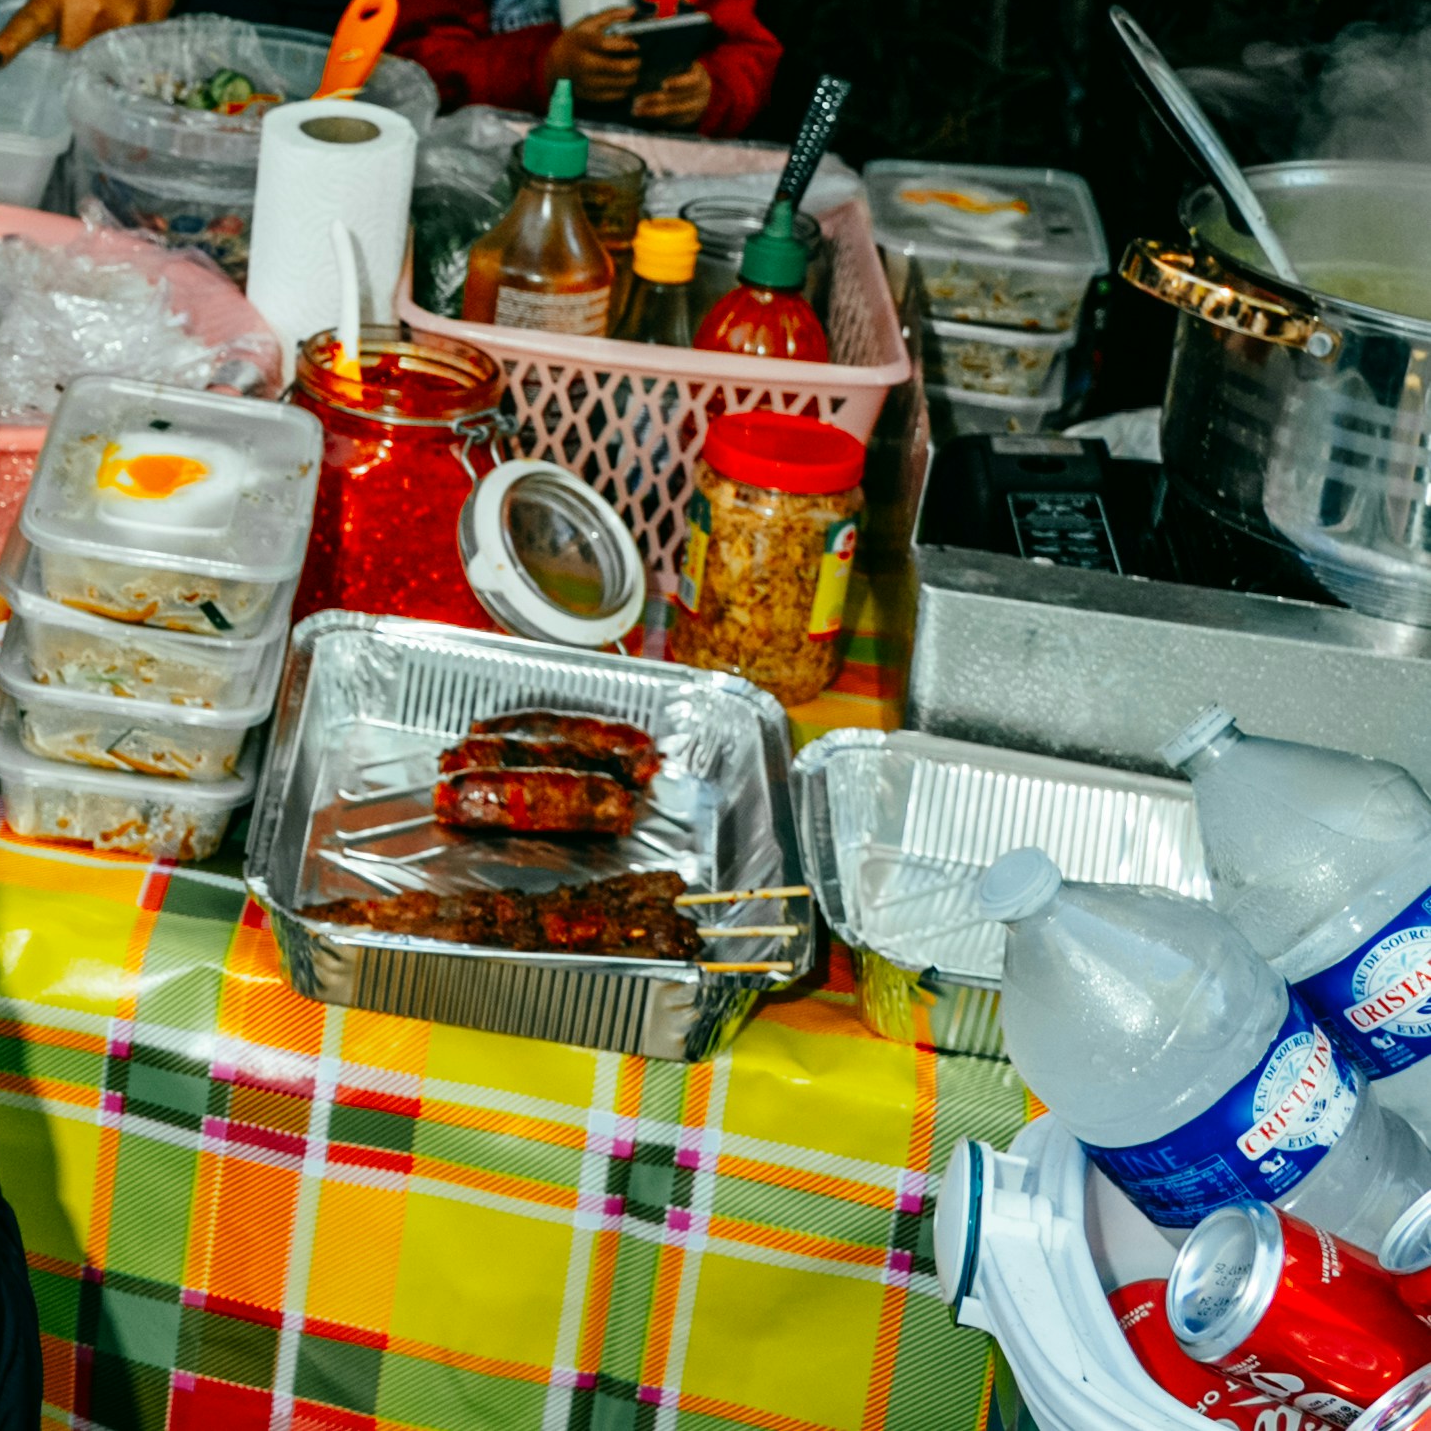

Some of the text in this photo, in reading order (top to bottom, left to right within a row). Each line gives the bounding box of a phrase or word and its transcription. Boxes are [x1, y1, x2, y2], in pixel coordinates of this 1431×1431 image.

[1350, 958, 1431, 1028] CRISTA
[1354, 928, 1431, 997] EAU DE SOURC
[1265, 1064, 1278, 1082] DE
[1275, 1033, 1312, 1061] SOURCE
